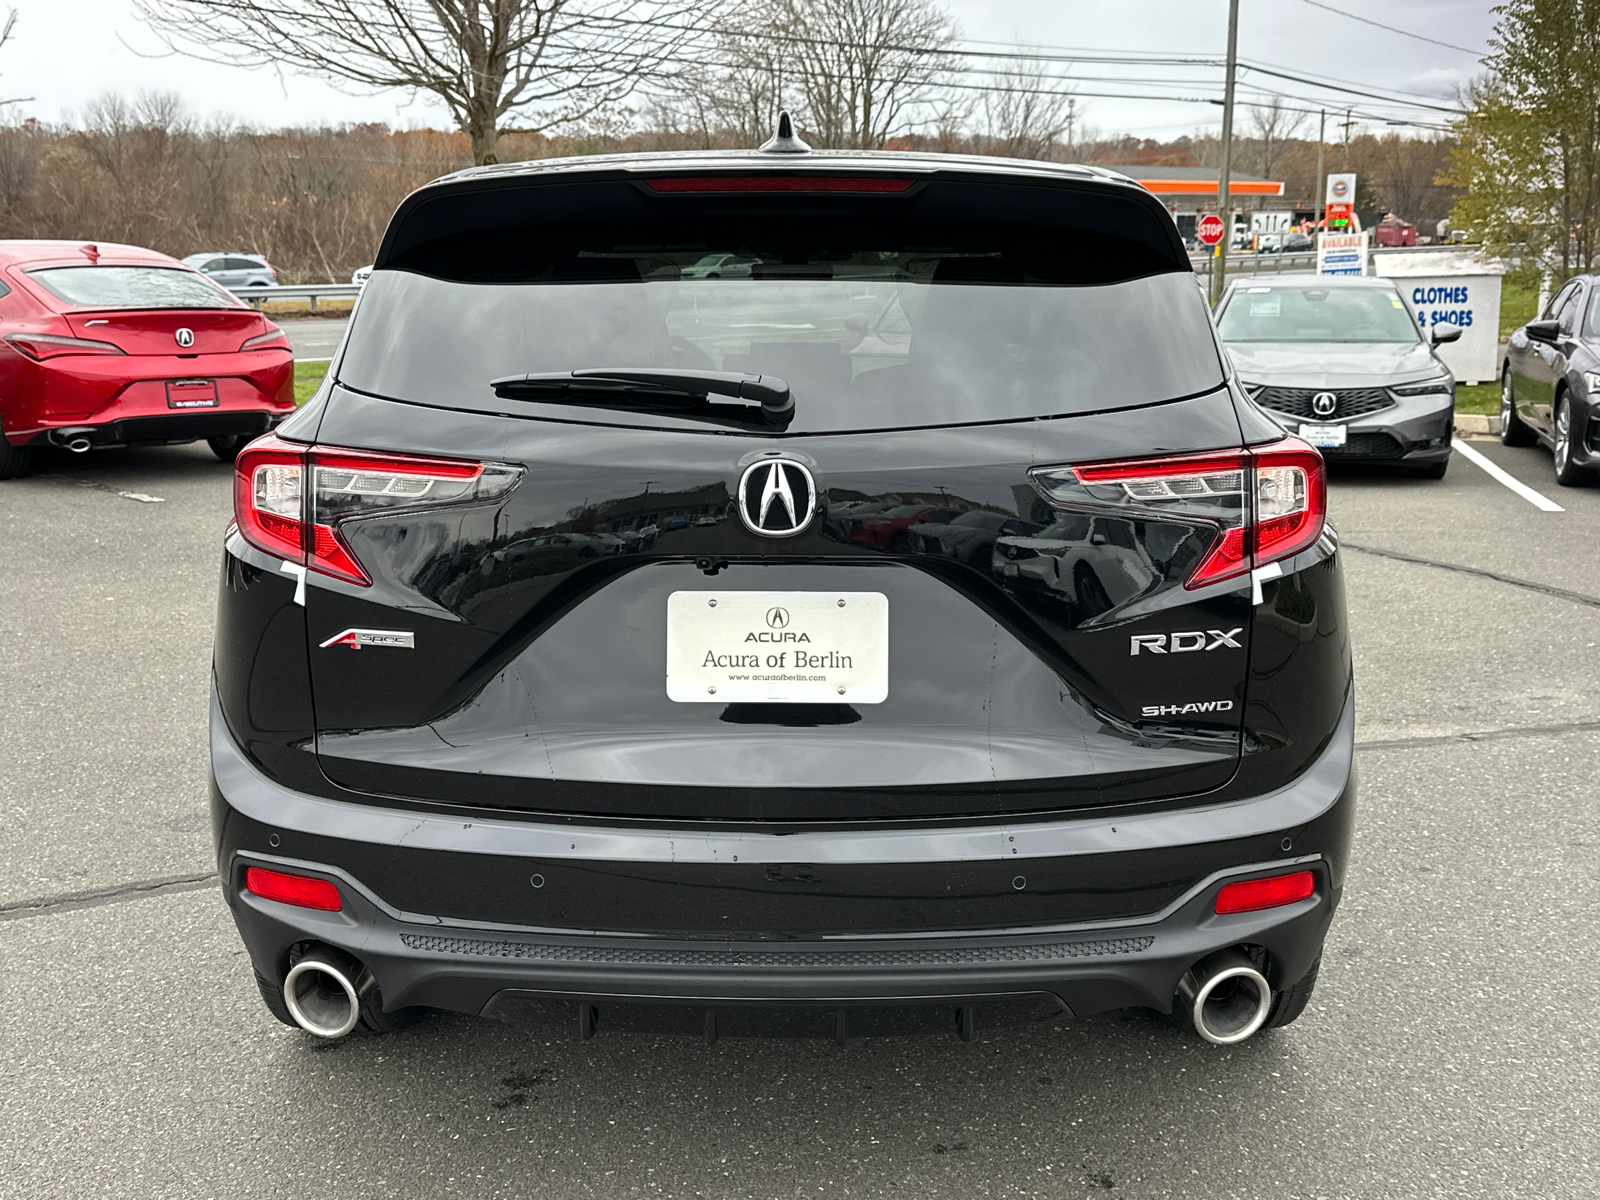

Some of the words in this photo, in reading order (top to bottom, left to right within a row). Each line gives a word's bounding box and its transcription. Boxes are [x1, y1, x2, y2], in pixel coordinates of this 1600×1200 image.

[1200, 223, 1223, 236] STOP
[1322, 236, 1362, 248] AVAILABLE
[1412, 286, 1468, 304] CLOTHES
[1418, 310, 1426, 327] &
[1431, 310, 1473, 327] SHOES
[744, 632, 811, 643] ACURA
[1130, 627, 1243, 656] RDX
[702, 650, 760, 668] Acura
[766, 652, 787, 668] of
[793, 650, 853, 669] Berlin
[1141, 700, 1233, 717] SH-AWD
